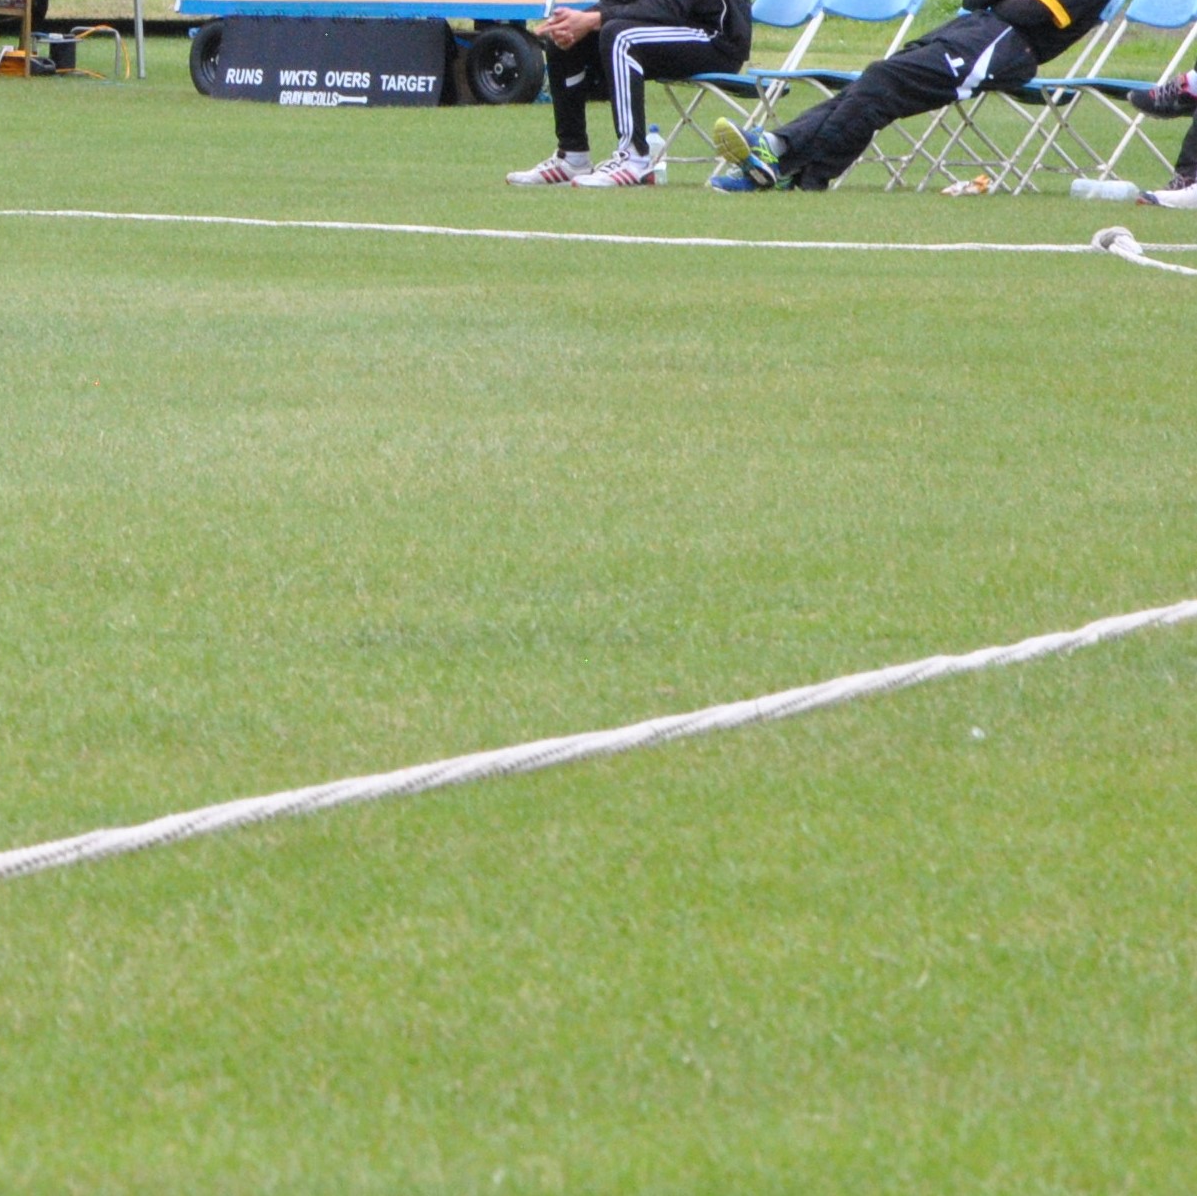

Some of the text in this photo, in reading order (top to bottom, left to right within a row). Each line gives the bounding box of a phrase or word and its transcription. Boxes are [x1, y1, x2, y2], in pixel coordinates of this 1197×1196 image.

[225, 68, 437, 92] RUNS WKTS OVERS TARGET
